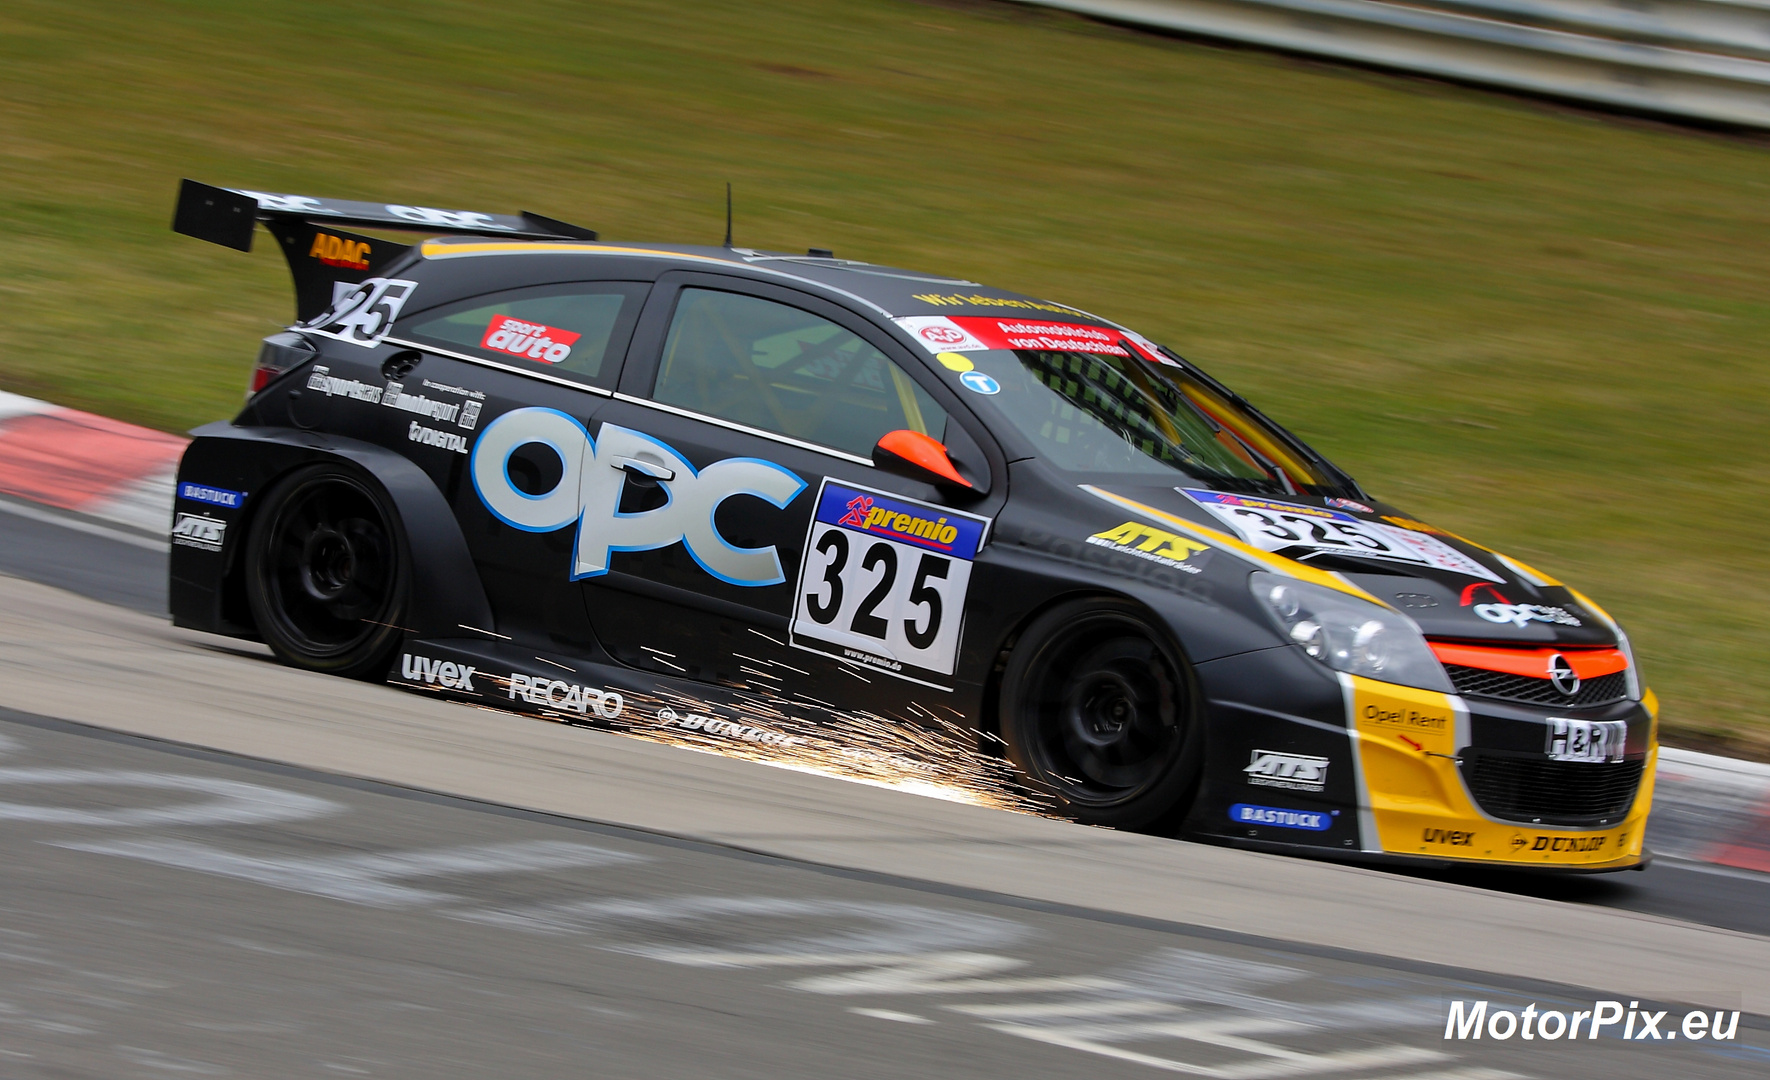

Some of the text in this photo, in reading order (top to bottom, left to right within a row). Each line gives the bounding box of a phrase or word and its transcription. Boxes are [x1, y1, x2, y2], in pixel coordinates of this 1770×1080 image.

[309, 232, 372, 265] ADAC
[912, 293, 964, 306] Wir
[499, 318, 548, 338] sport
[997, 321, 1110, 342] Automobilclub
[486, 329, 572, 364] auto
[1008, 338, 1045, 349] von
[1038, 336, 1131, 356] Deutschlan
[184, 485, 237, 506] BASTUCK
[470, 406, 809, 587] OPC
[172, 516, 227, 541] ATS
[862, 505, 958, 545] premio
[1234, 508, 1390, 551] 325
[1092, 521, 1211, 562] ATS
[806, 529, 952, 650] 325
[402, 653, 476, 692] uvex
[844, 648, 902, 672] www.premio.de
[509, 673, 624, 719] RECARO
[1363, 704, 1447, 730] Opel Rent
[1243, 754, 1331, 780] ATS
[1241, 807, 1321, 828] BASTUCK
[1424, 827, 1476, 847] uvex
[1532, 836, 1607, 853] DUNLOP
